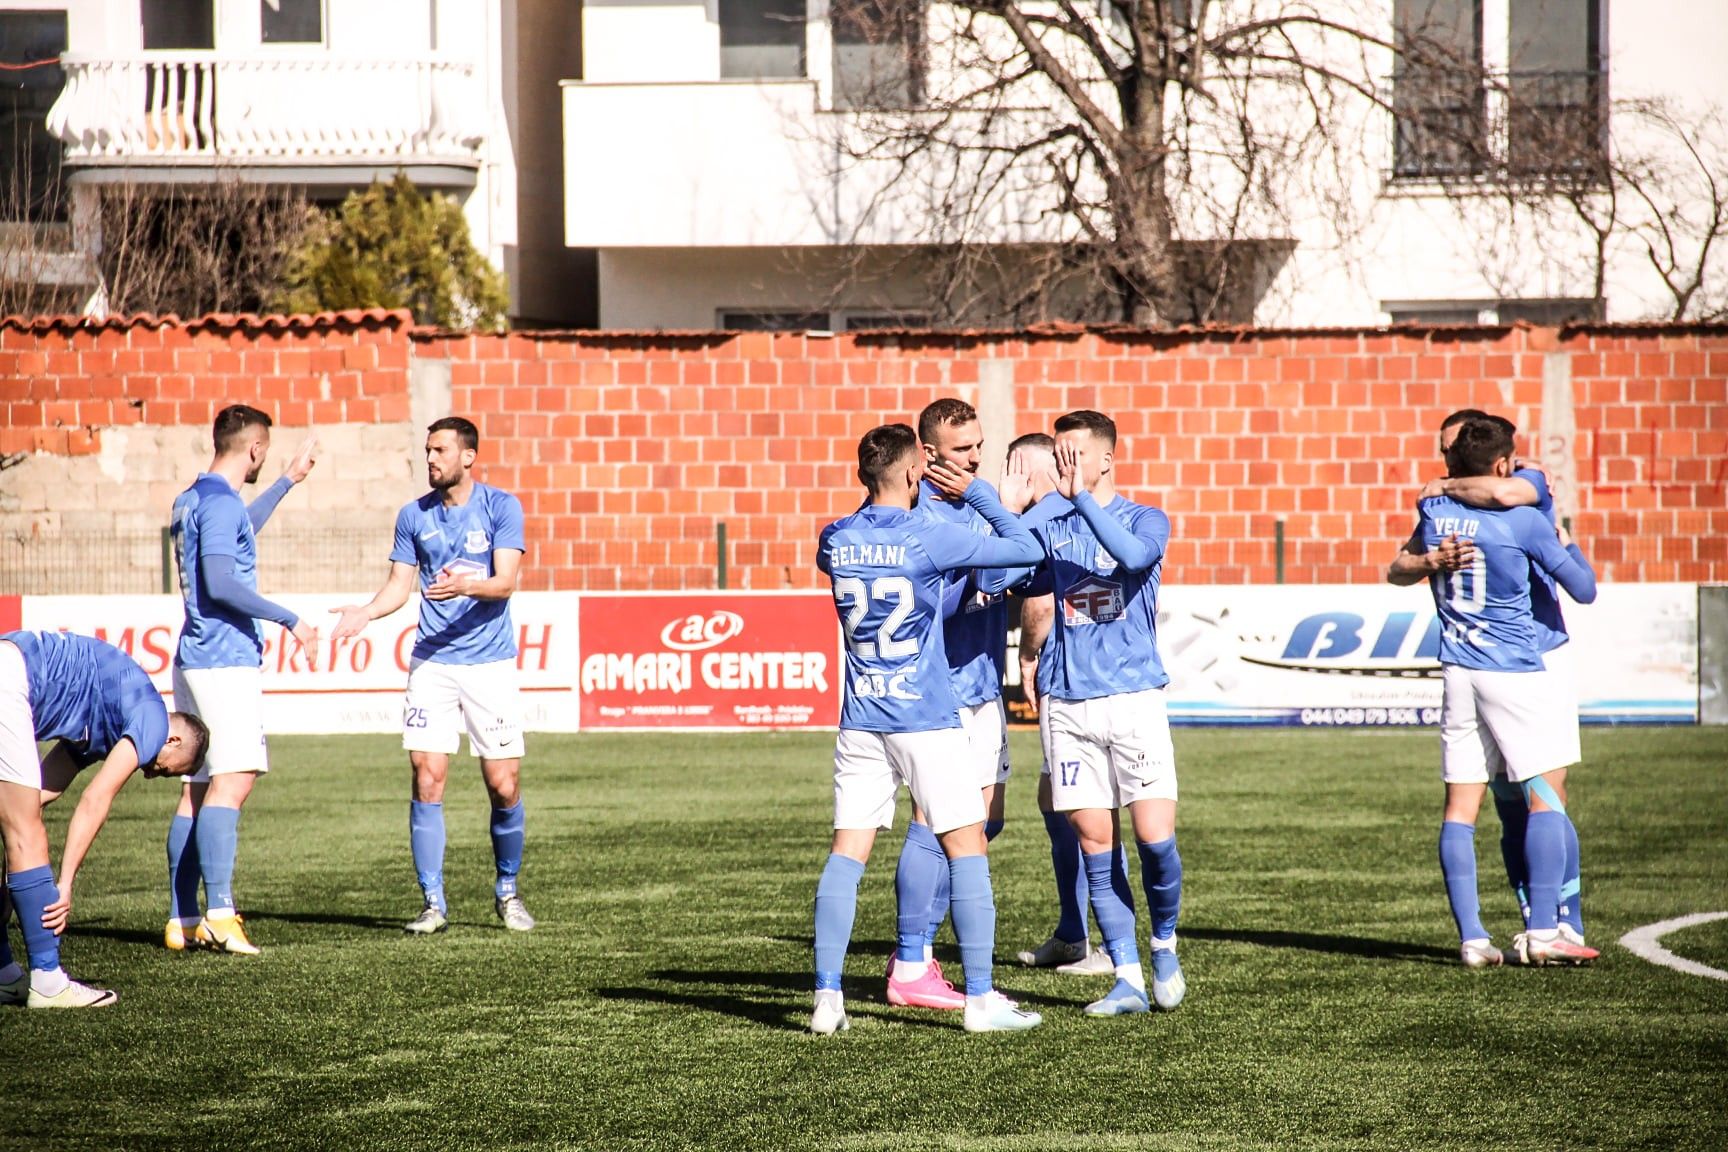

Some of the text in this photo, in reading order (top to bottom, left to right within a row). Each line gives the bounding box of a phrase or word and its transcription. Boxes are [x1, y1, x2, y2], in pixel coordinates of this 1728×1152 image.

[1434, 517, 1480, 537] VELIU
[831, 544, 905, 568] SELMANI
[834, 576, 919, 659] 22
[581, 652, 829, 695] AMARI CENTER
[406, 707, 428, 729] 25
[1060, 761, 1081, 787] 17
